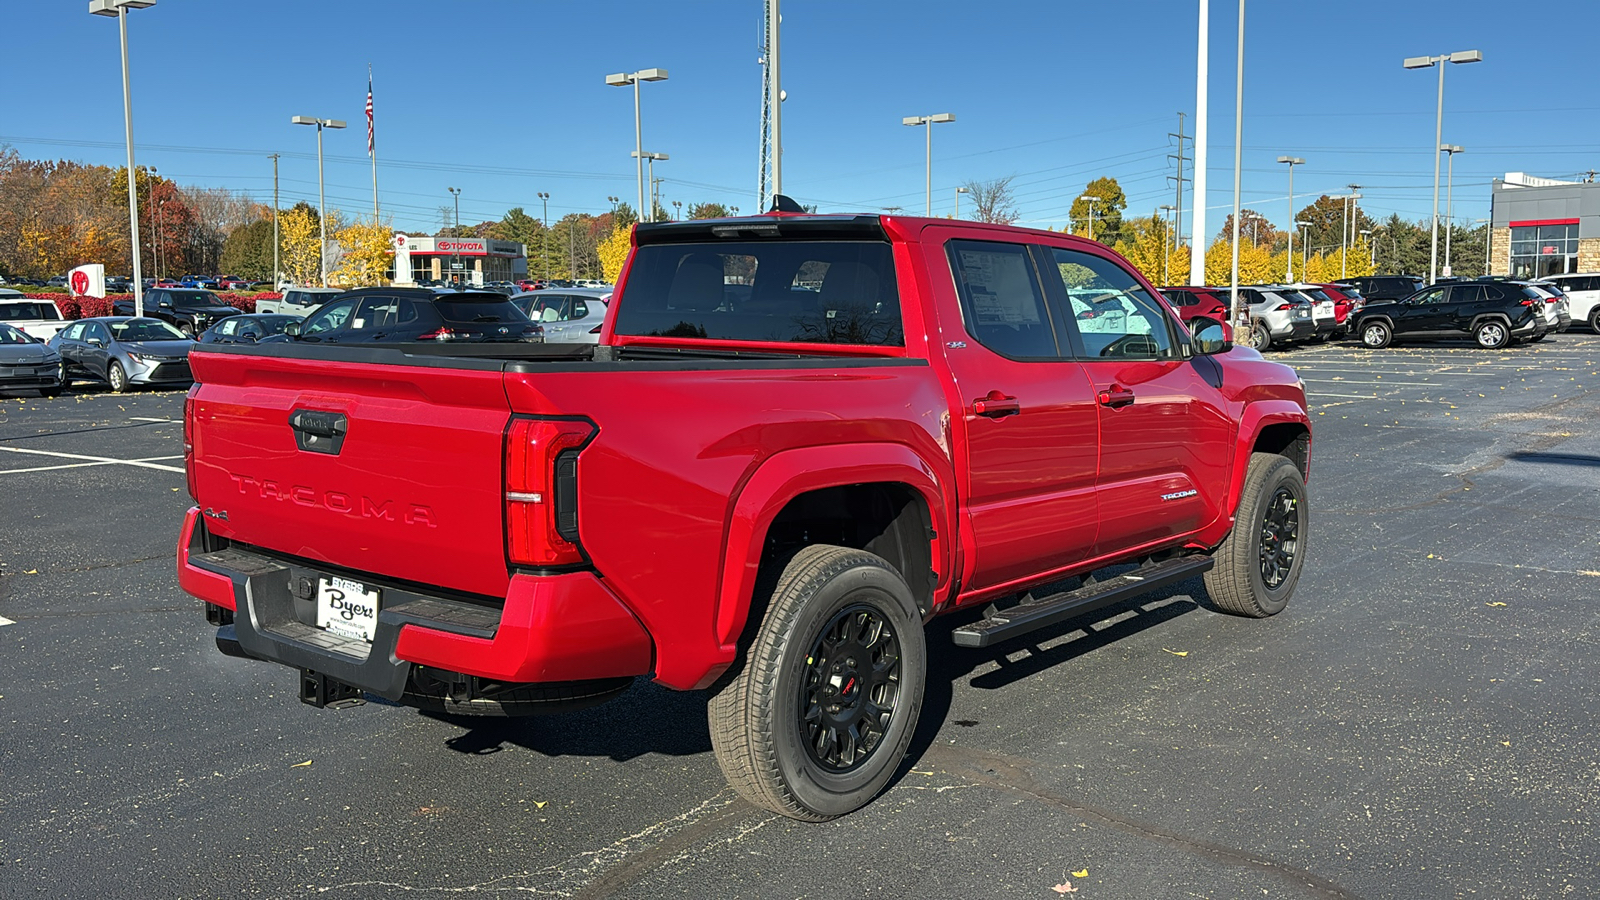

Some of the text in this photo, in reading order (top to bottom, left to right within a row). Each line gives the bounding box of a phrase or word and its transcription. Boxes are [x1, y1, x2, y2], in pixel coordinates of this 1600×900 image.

[230, 472, 437, 528] TACOMA
[1160, 489, 1198, 501] TACOMA
[324, 588, 374, 621] Byers
